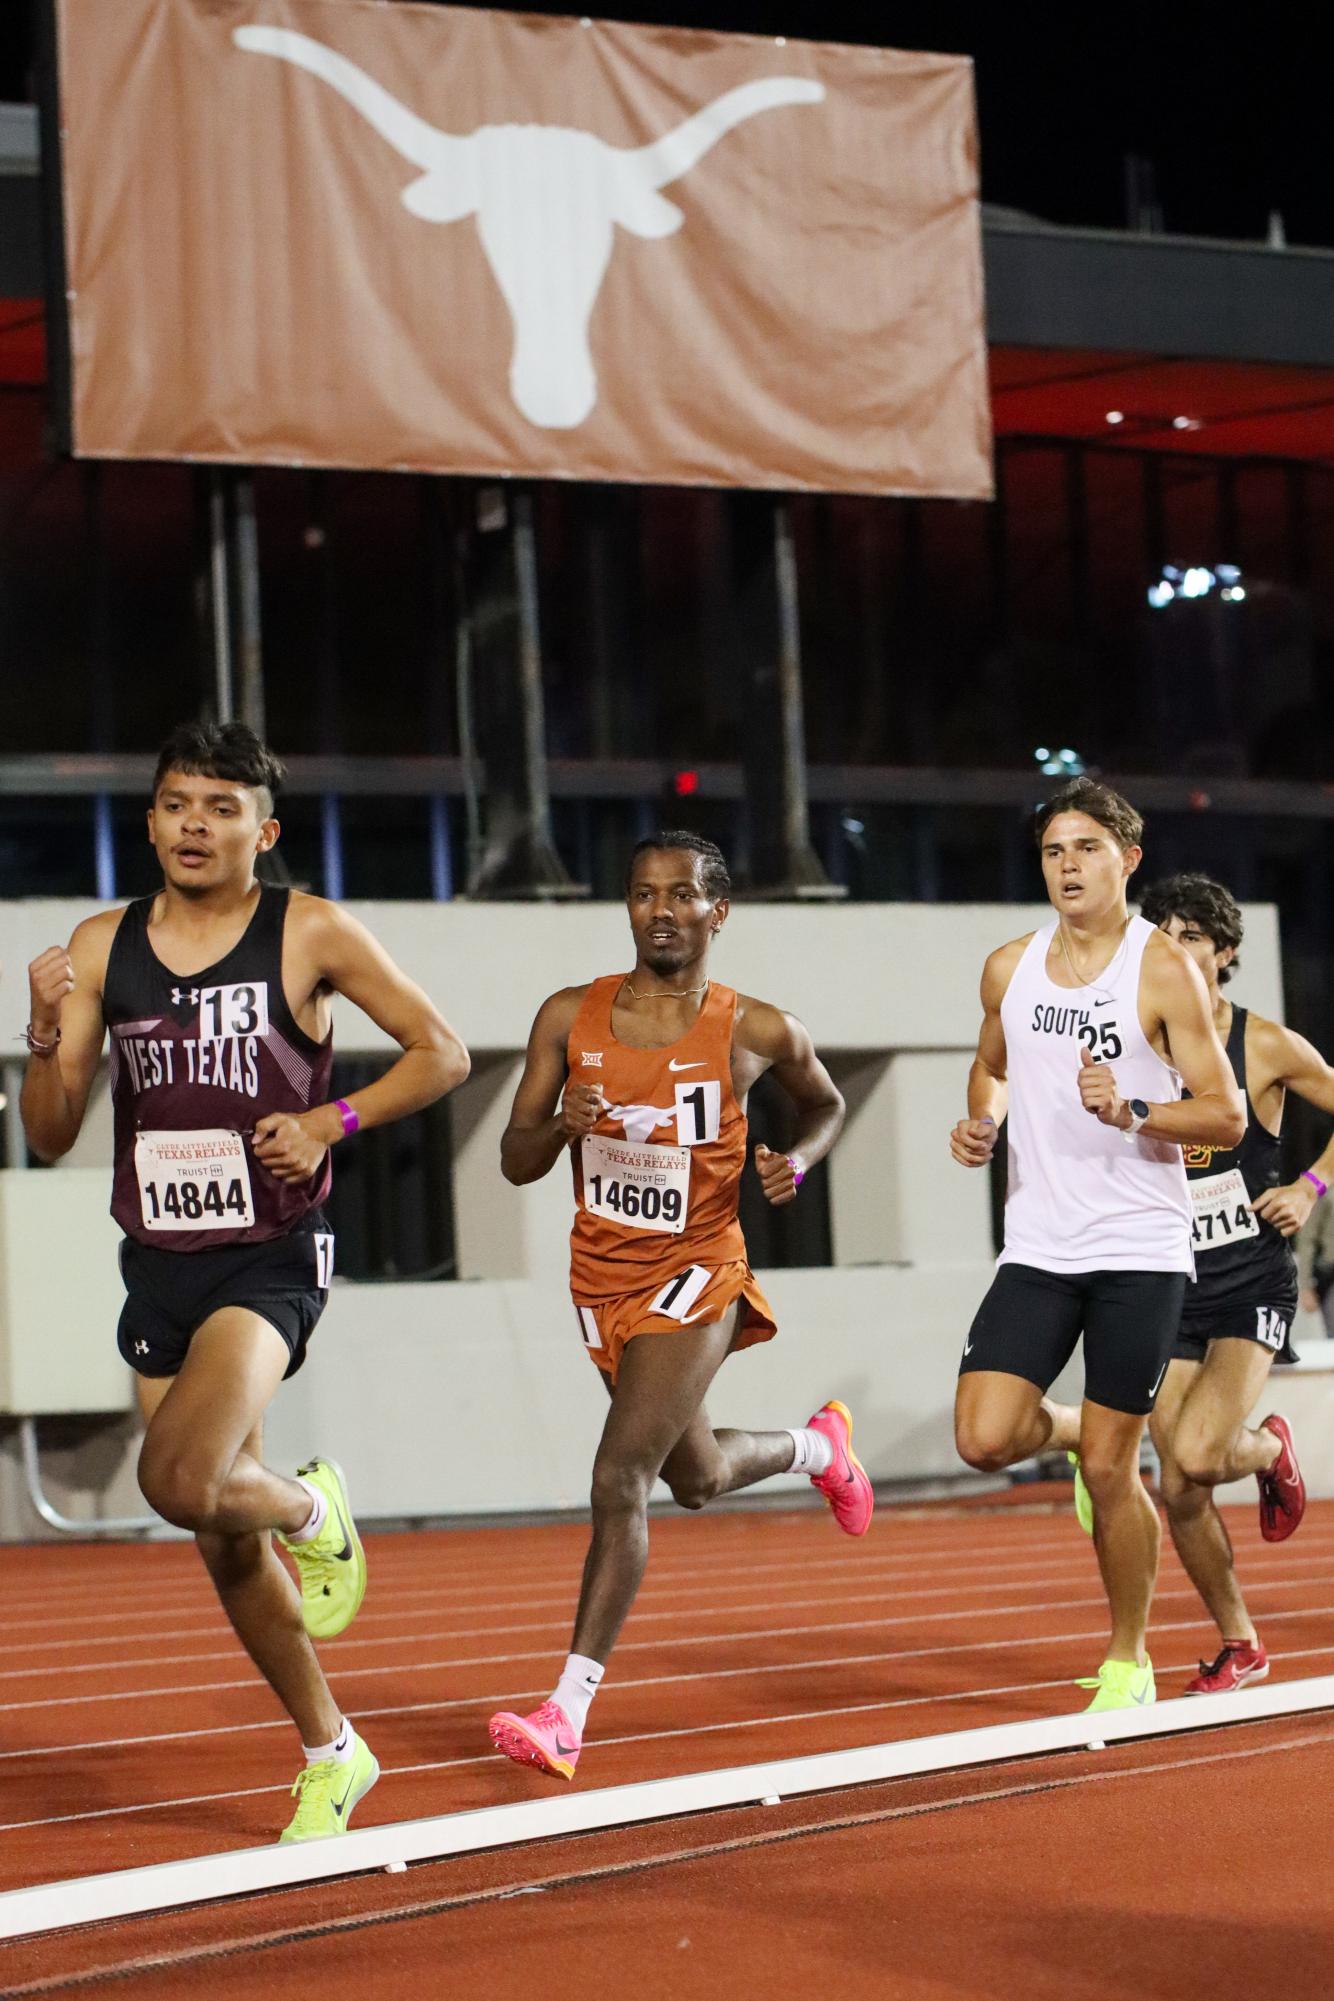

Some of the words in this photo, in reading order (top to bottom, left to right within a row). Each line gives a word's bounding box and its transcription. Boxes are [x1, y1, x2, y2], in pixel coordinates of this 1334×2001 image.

[205, 986, 258, 1036] 13
[1032, 1004, 1090, 1036] SOUTH
[1078, 1021, 1122, 1062] 25
[120, 1039, 173, 1096] WEST
[183, 1036, 258, 1098] TEXAS
[683, 1086, 706, 1141] 1
[157, 1149, 192, 1160] TEXAS
[195, 1146, 240, 1159] RELAYS
[182, 1140, 239, 1149] LITTLEFIELD
[607, 1147, 630, 1157] CLYDE
[633, 1151, 687, 1162] LITTLEFIELD
[607, 1152, 641, 1167] TEXAS
[644, 1159, 686, 1170] RELAYS
[177, 1167, 208, 1176] TRUIST
[623, 1172, 653, 1182] TRUIST
[145, 1178, 247, 1219] 14844
[590, 1174, 682, 1222] 14609
[660, 1268, 695, 1310] 1
